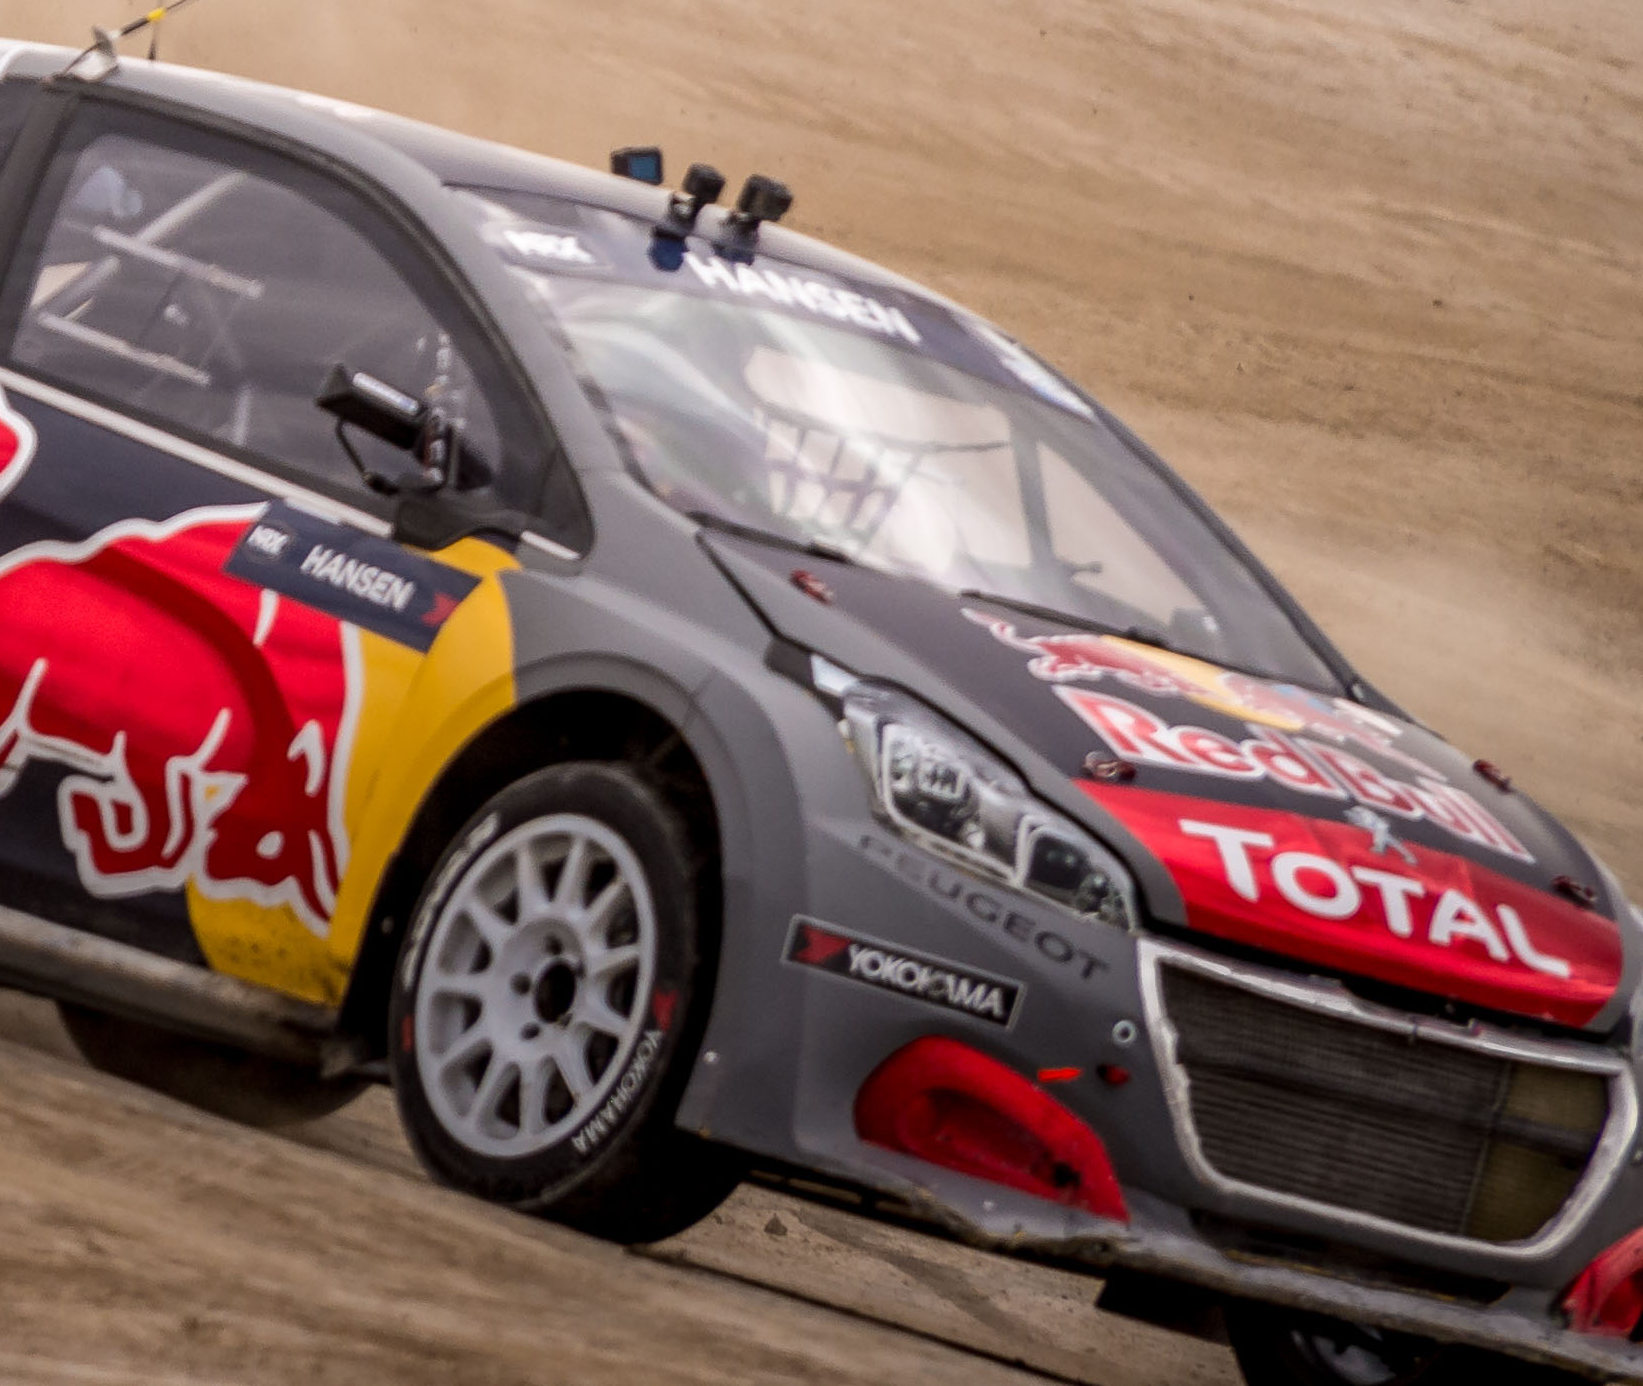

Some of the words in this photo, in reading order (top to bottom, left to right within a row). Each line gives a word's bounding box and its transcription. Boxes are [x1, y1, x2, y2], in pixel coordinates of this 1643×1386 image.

[682, 250, 922, 345] HANSEN
[300, 544, 415, 612] HANSEN
[1050, 683, 1346, 800] Red
[1296, 736, 1536, 864] Bull
[1178, 818, 1570, 979] TOTAL
